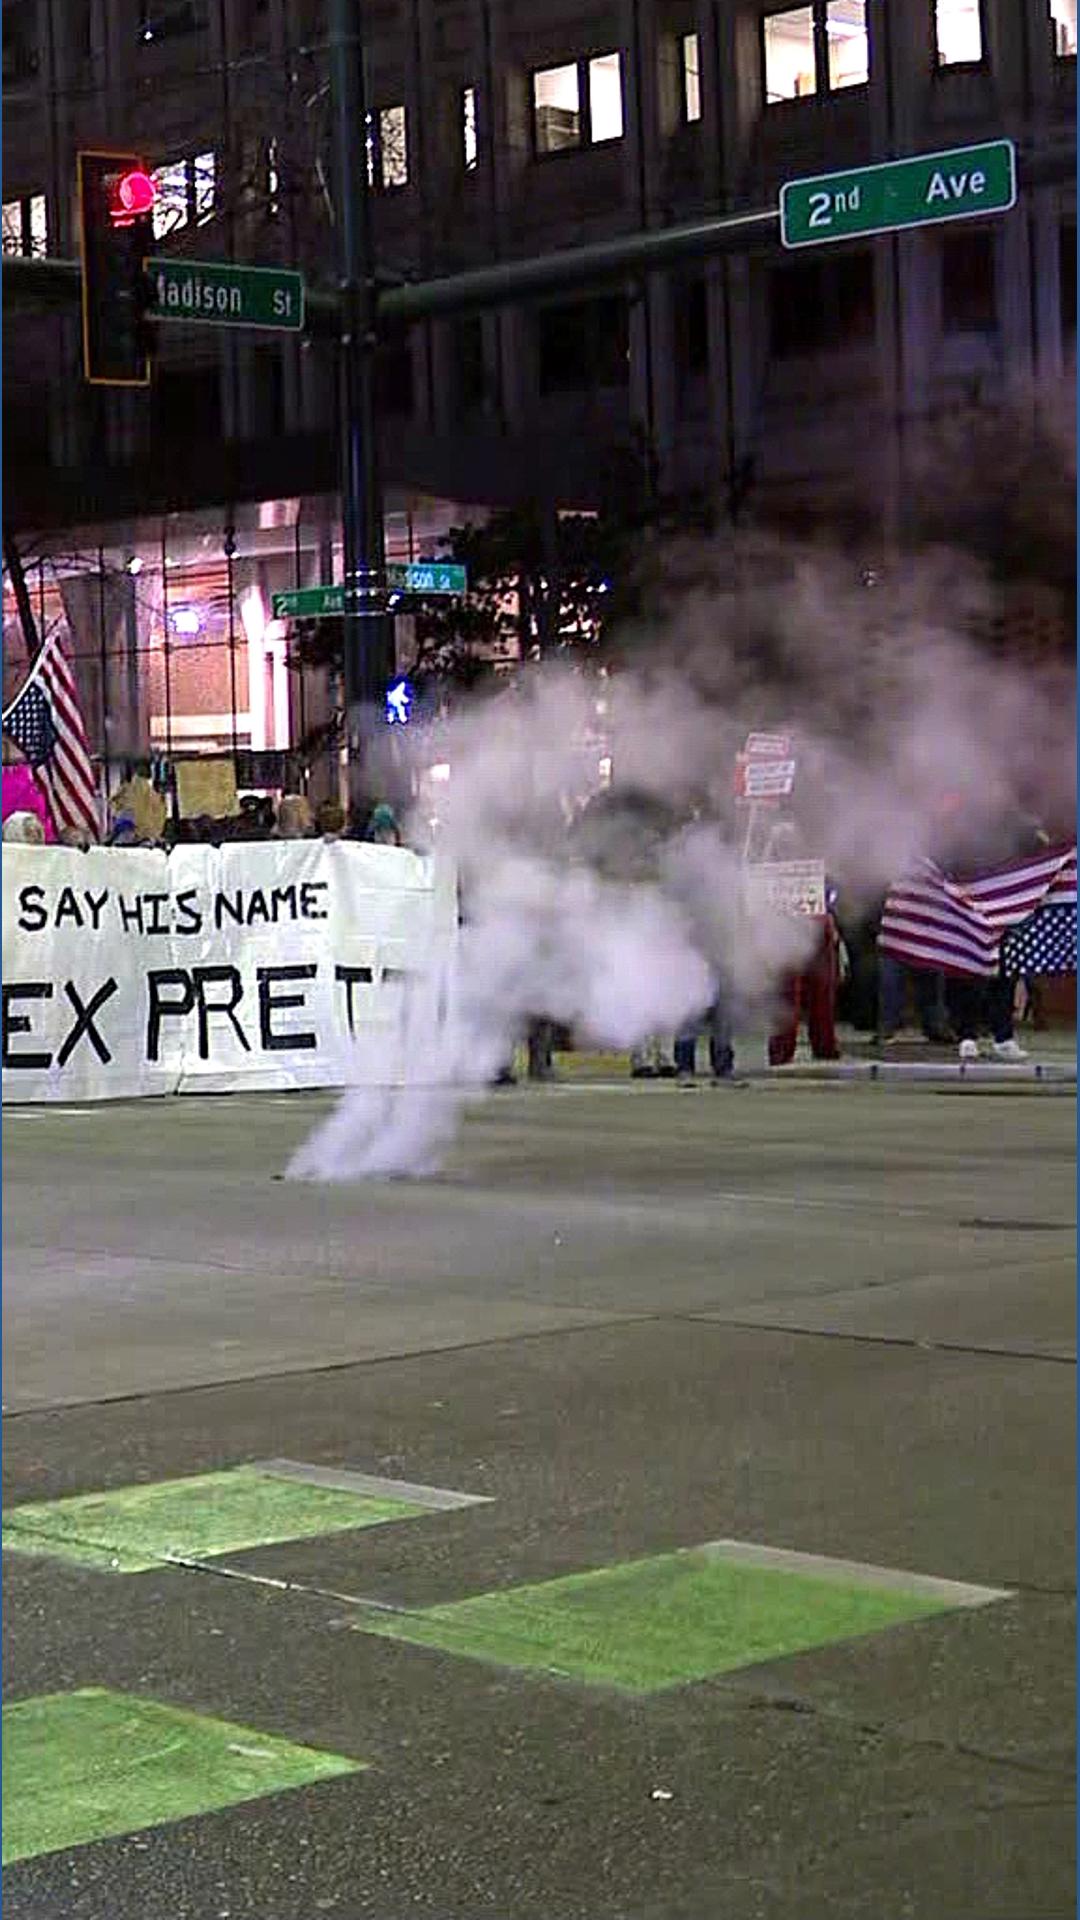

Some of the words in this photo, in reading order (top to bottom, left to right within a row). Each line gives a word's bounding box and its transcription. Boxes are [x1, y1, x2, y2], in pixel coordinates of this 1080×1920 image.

[808, 185, 861, 228] 2nd
[926, 171, 986, 204] Ave
[273, 288, 291, 317] St
[18, 885, 108, 932] SAY
[118, 889, 203, 935] HIS
[215, 882, 328, 929] NAME
